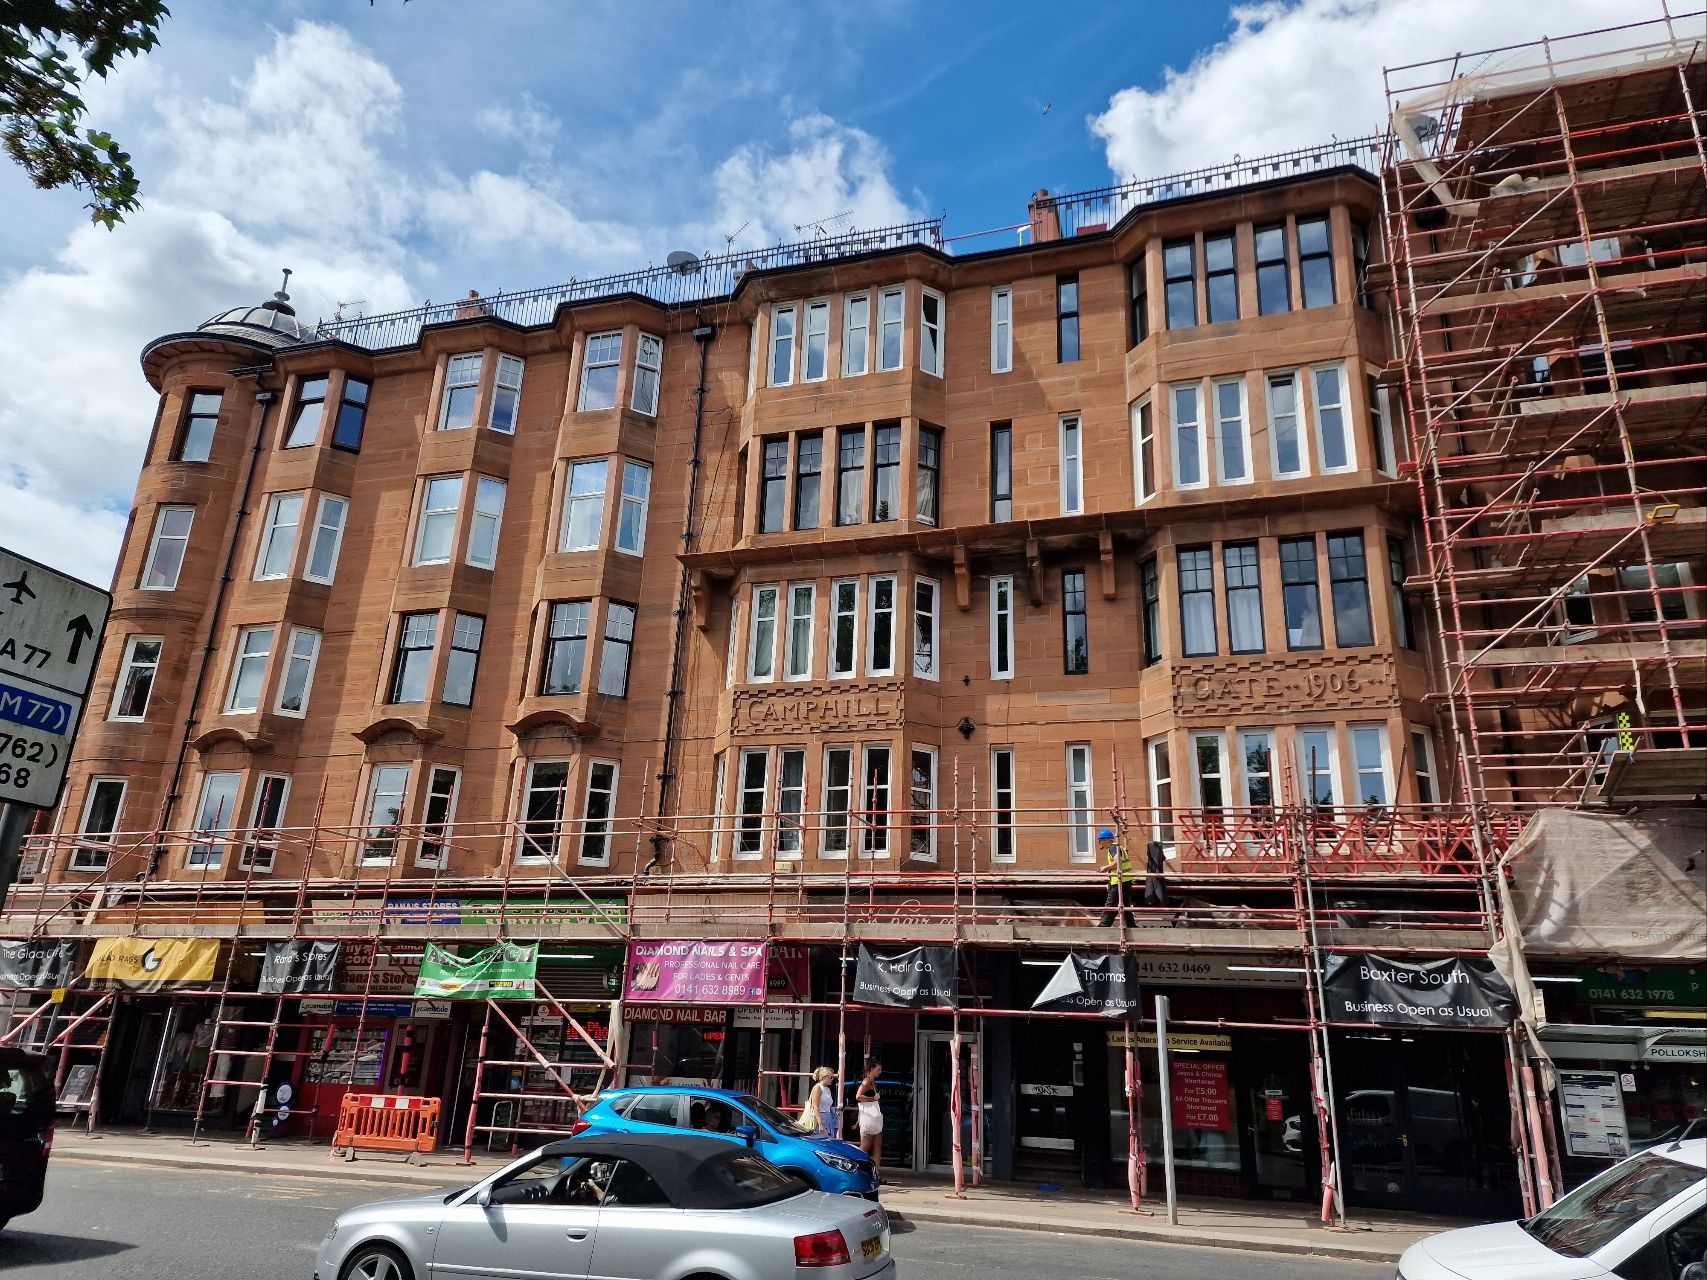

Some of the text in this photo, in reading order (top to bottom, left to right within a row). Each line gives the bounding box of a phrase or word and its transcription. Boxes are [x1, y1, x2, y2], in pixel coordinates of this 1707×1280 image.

[1192, 667, 1362, 700] GATE 1906
[748, 696, 890, 727] CAMPHILL
[635, 945, 763, 957] DIAMOND NAILS & SPA
[118, 955, 139, 964] RAGS
[664, 960, 761, 970] PROFESSIONAL NAIL CARE
[889, 960, 913, 973] Hair
[914, 960, 935, 973] Co.
[1158, 962, 1180, 973] 632
[1182, 962, 1211, 974] 0469
[673, 972, 750, 981] FOR LADIES & GENTS
[1083, 968, 1127, 983] Thomas
[1360, 965, 1470, 985] Baxter South
[674, 984, 746, 996] 0141 632 8989
[859, 981, 891, 994] Business
[919, 988, 929, 996] as
[931, 987, 951, 998] Usual
[1588, 988, 1675, 1000] 0141 632 1978
[1076, 996, 1103, 1008] Open
[1115, 999, 1137, 1008] Usual
[1344, 1000, 1493, 1017] Business Open as Usual
[624, 1007, 727, 1023] DIAMOND NAIL BAR
[1112, 1035, 1135, 1043] Lads
[1136, 1036, 1170, 1045] Alteran
[1171, 1038, 1198, 1046] Service
[1199, 1038, 1232, 1048] Available
[1651, 1048, 1706, 1058] POLLOKSH
[1174, 1062, 1225, 1071] SPECIAL OFFER
[1195, 1087, 1217, 1096] £5.00
[1197, 1114, 1219, 1122] £7.00
